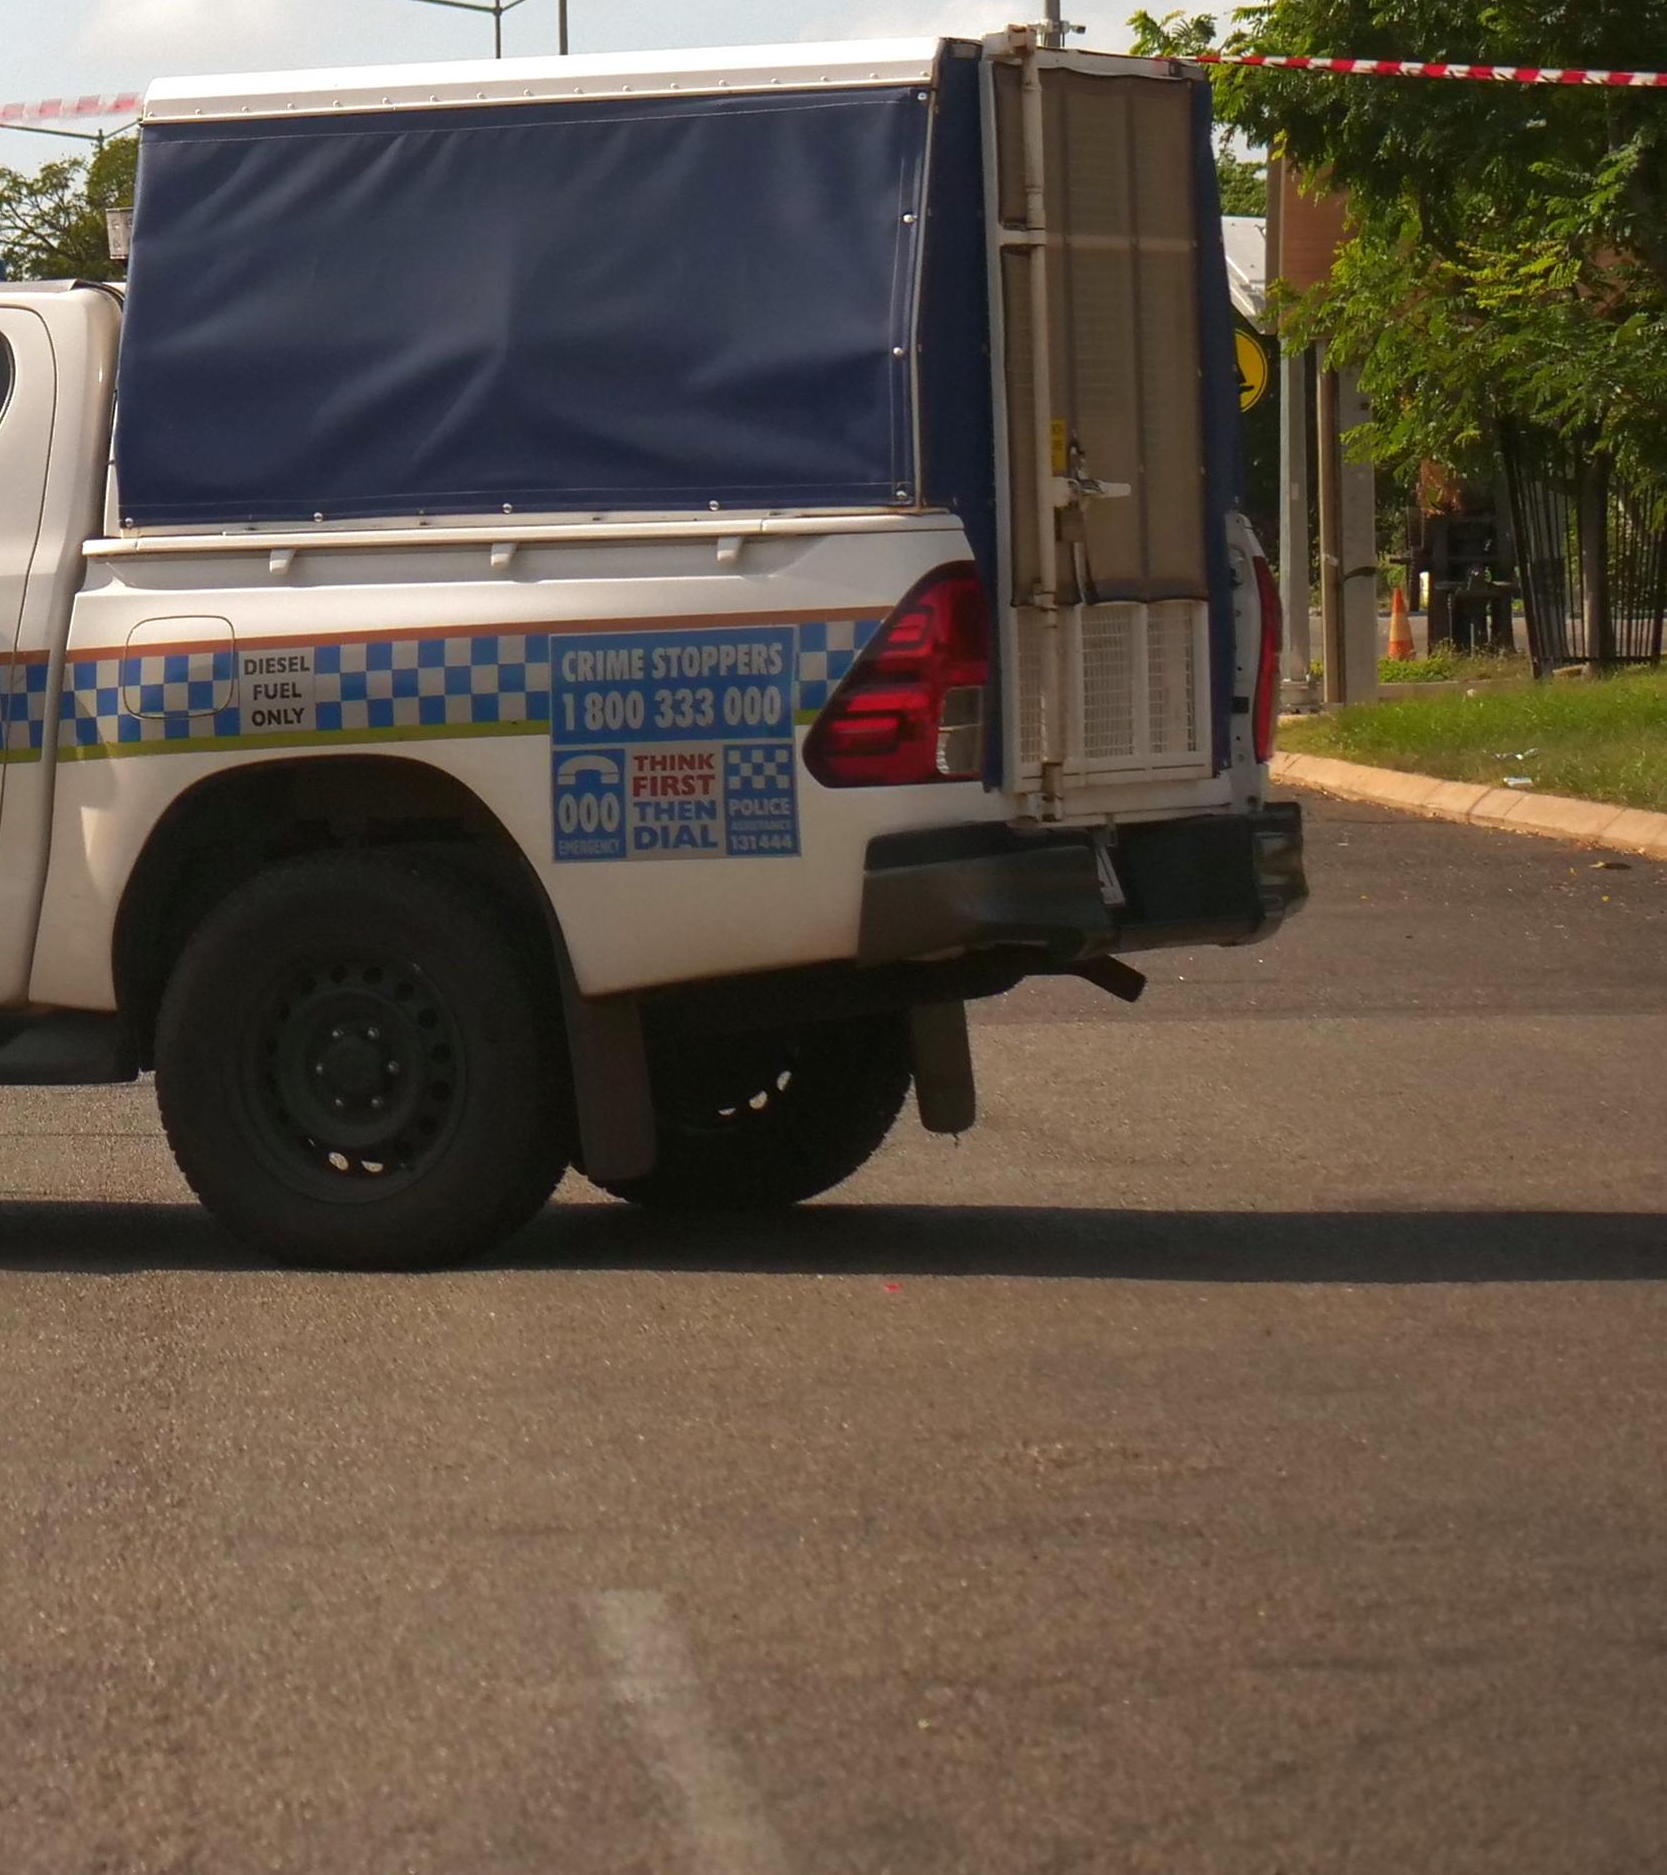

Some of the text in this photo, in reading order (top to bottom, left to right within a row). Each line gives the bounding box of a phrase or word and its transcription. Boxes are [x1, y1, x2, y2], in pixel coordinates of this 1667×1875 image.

[243, 655, 311, 676] DIESEL
[562, 642, 783, 682] CRIME STOPPERS
[253, 682, 303, 701] FUEL
[251, 707, 306, 727] ONLY
[562, 685, 782, 731] 1 800 333 000
[633, 753, 715, 772] THINK
[632, 774, 716, 798] FIRST
[557, 792, 621, 833] 000
[632, 800, 717, 822] THEN
[728, 797, 791, 816] POLICE
[633, 824, 719, 850] DIAL
